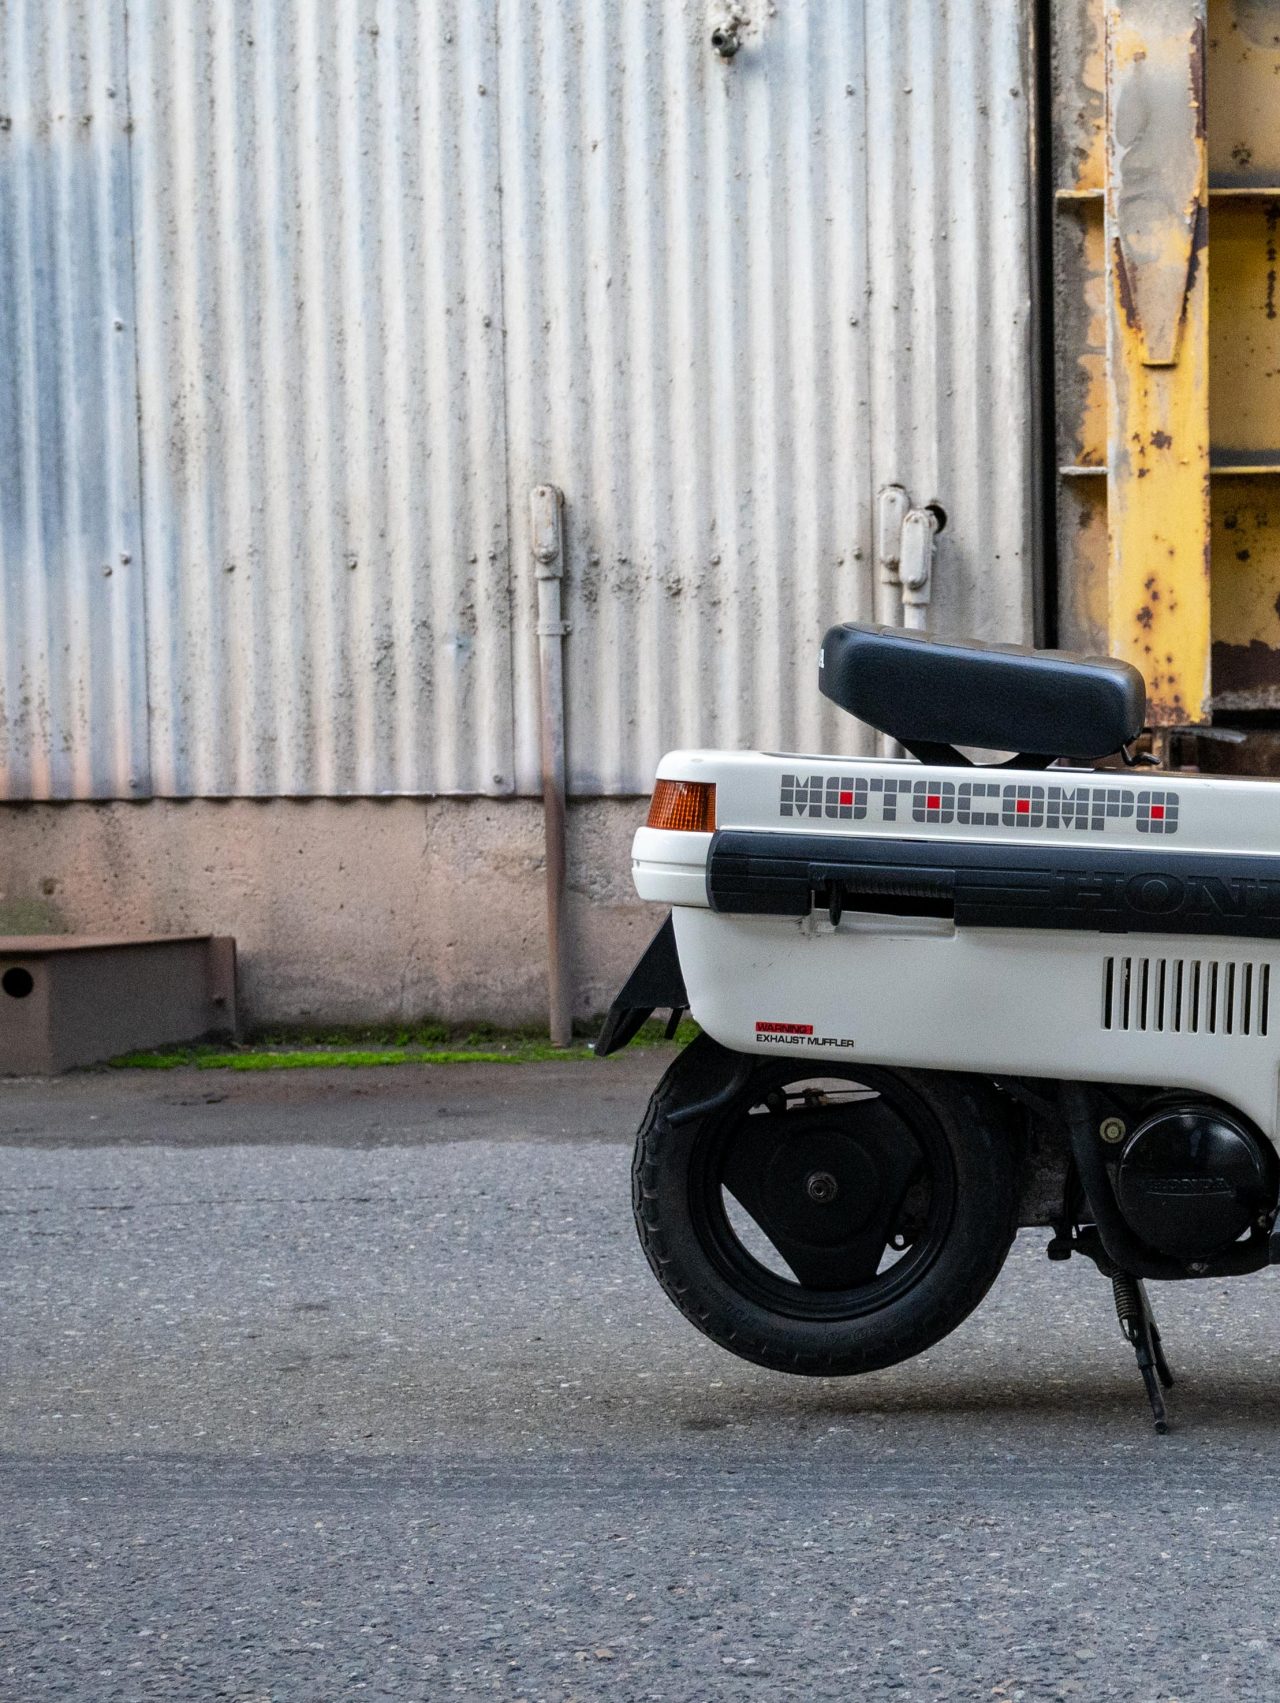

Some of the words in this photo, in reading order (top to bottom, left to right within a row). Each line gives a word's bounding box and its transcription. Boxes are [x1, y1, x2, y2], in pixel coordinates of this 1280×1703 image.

[780, 774, 1179, 834] MOTOCOMPO
[756, 1034, 805, 1044] EXHAUST
[807, 1037, 854, 1047] MUFFLER
